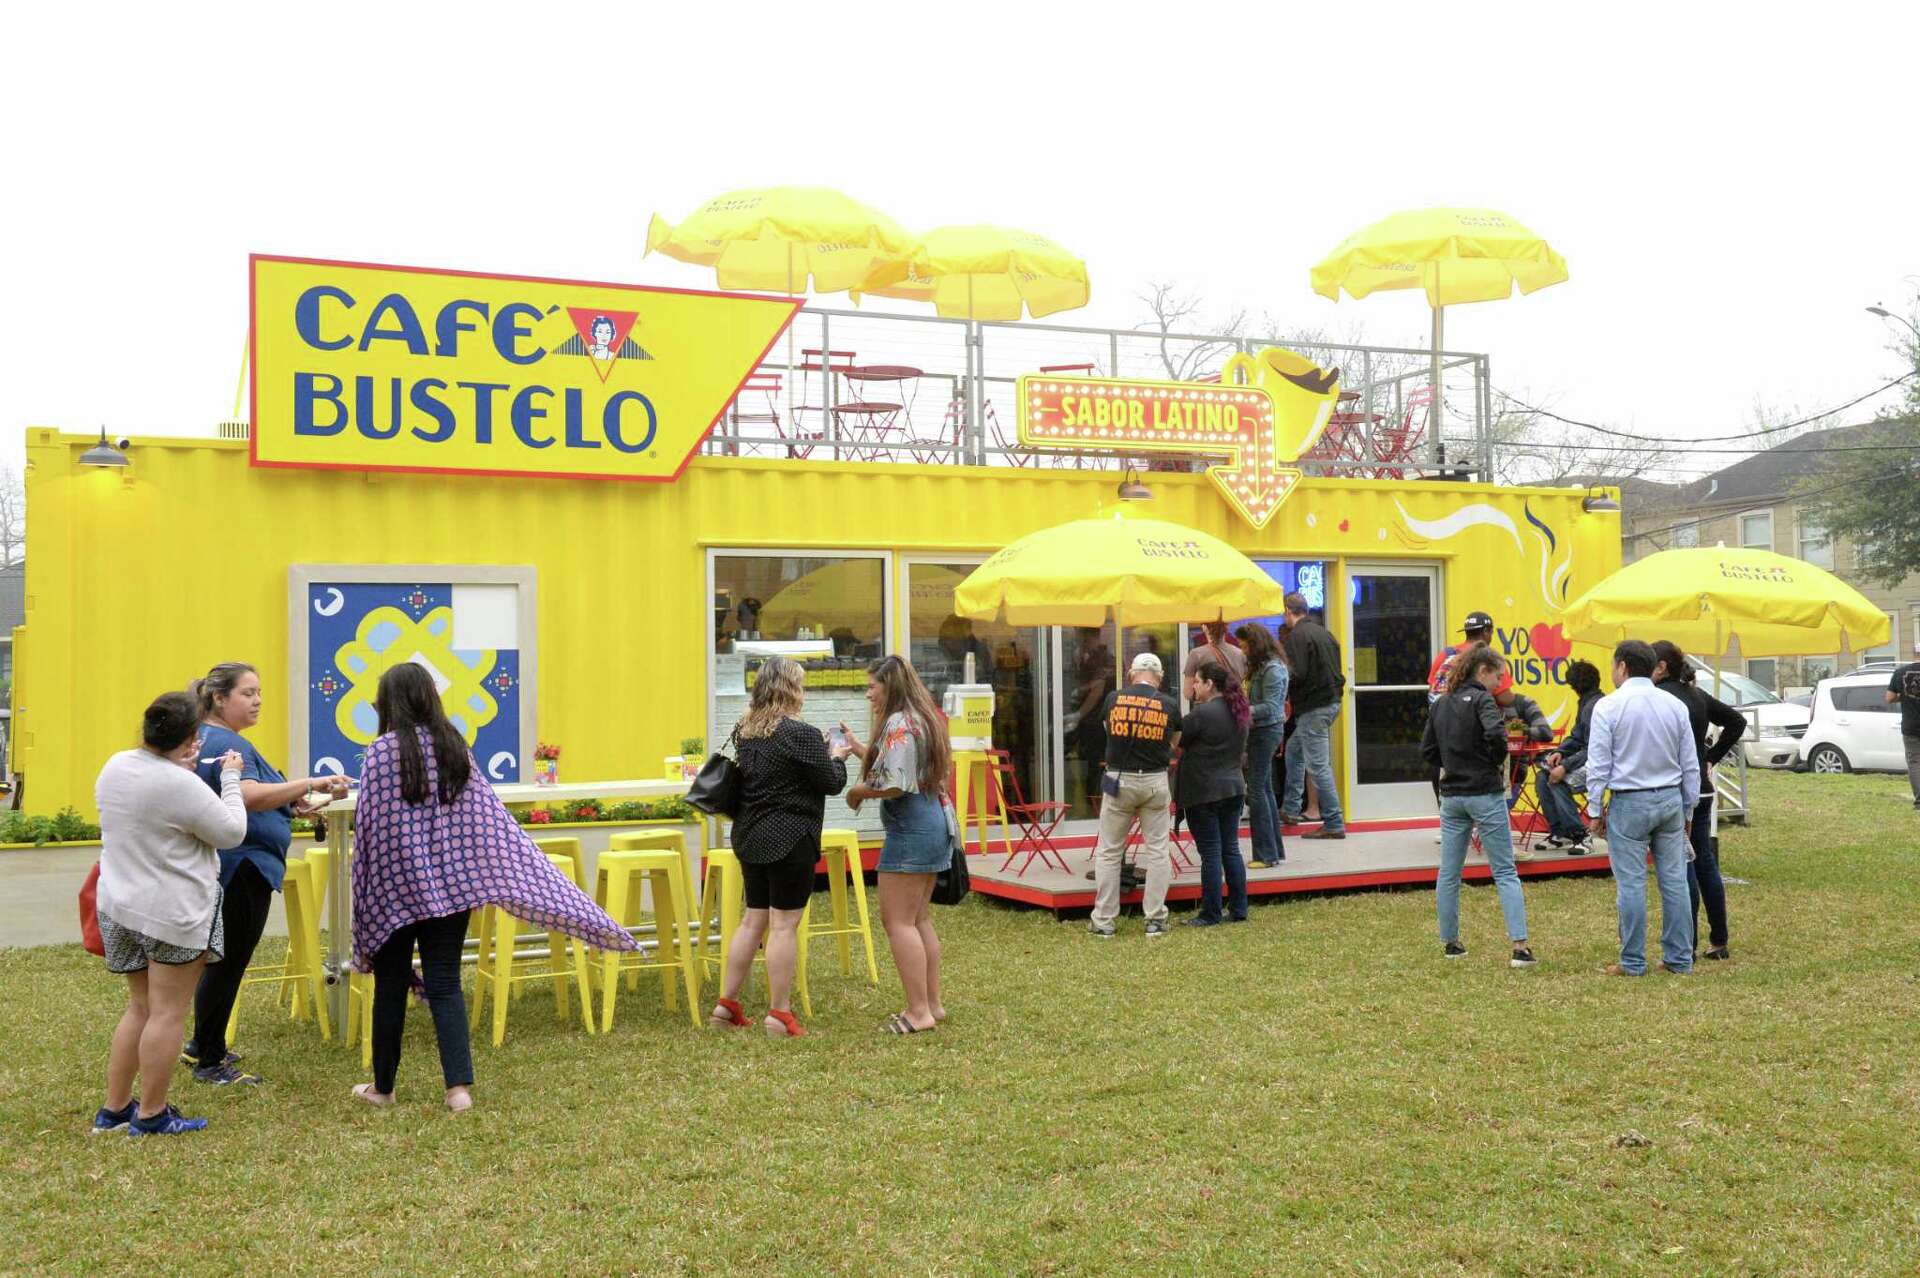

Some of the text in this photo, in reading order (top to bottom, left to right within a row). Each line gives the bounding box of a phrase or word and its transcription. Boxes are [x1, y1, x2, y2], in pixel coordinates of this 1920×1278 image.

[295, 285, 560, 365] CAFÉ
[294, 372, 657, 453] BUSTELO
[1061, 397, 1239, 433] SABOR LATINO
[1497, 627, 1530, 655] YO
